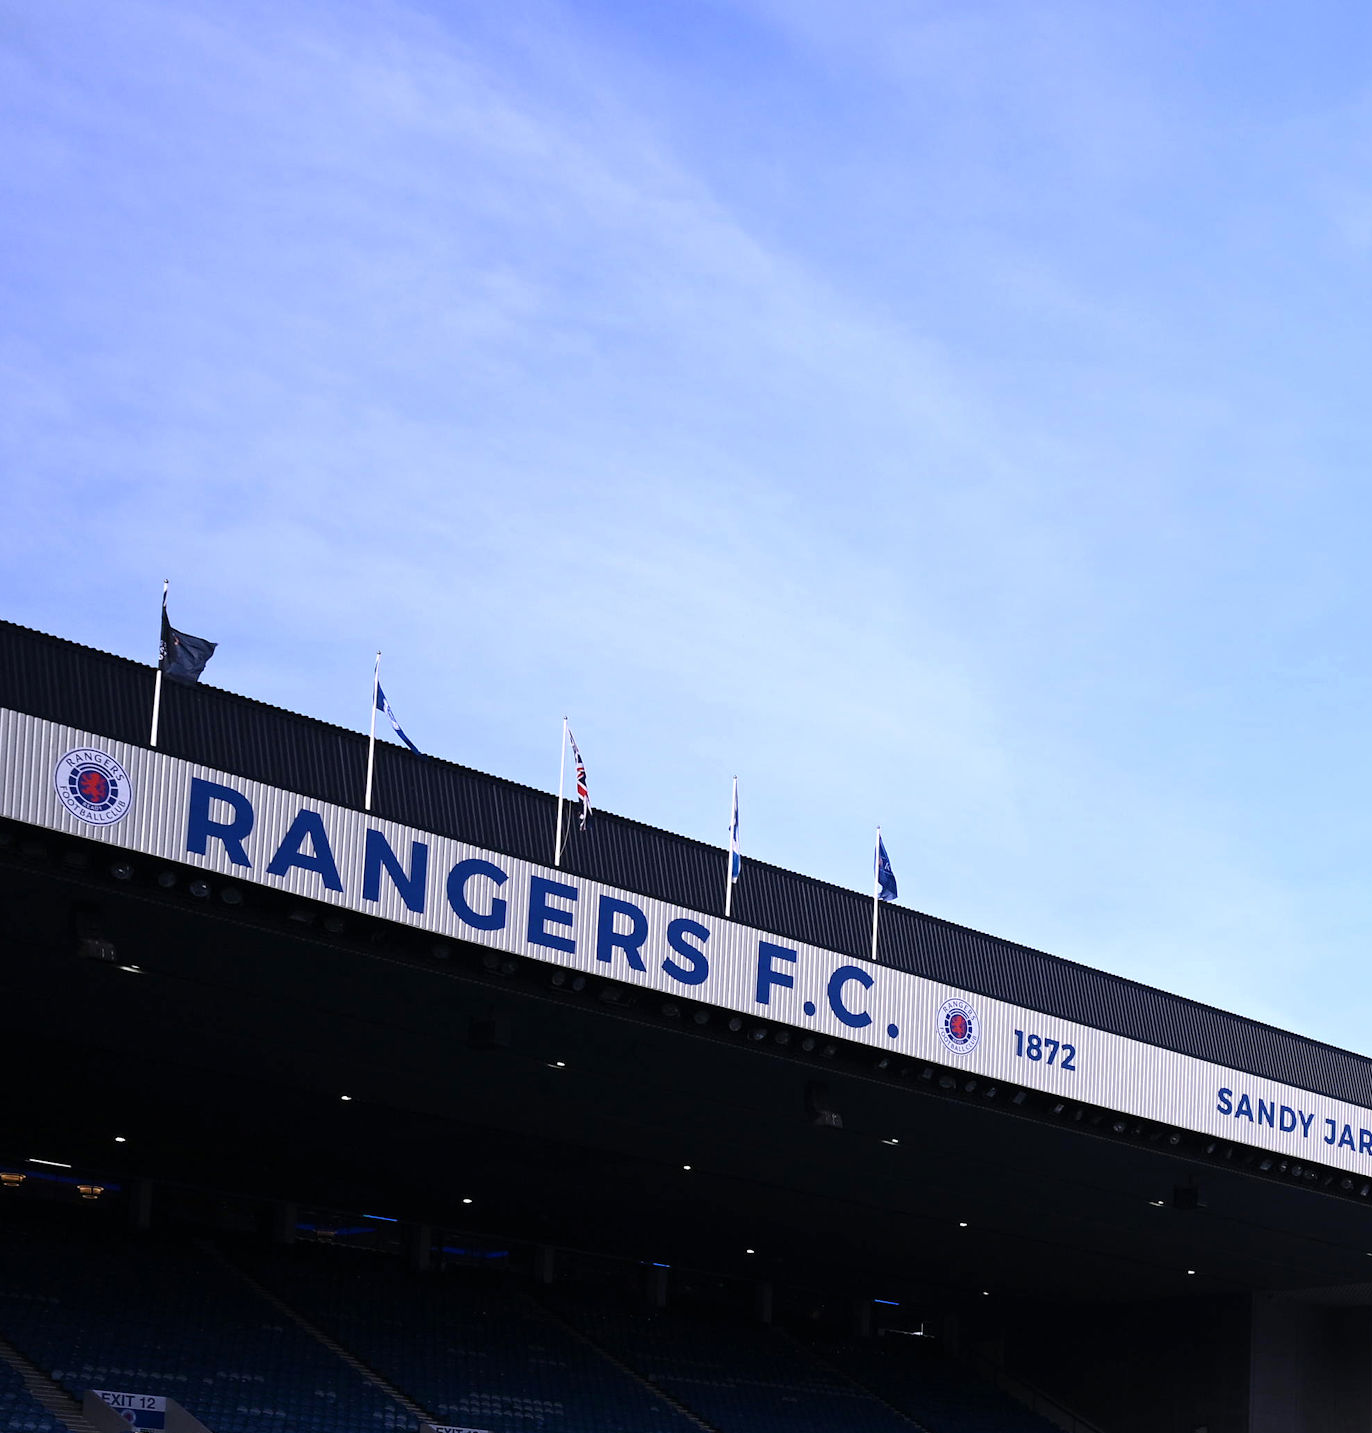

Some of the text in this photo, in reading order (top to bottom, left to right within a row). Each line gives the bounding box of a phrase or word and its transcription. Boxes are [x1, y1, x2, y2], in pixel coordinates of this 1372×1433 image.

[65, 752, 125, 781] RANGERS
[60, 786, 126, 820] FOOTBALL CLUB
[186, 777, 899, 1038] RANGERS F.C.
[943, 1001, 976, 1021] RANGERS
[940, 1027, 977, 1051] FOOTBALL CLUB
[1014, 1029, 1076, 1071] 1872
[1216, 1087, 1314, 1138] SANDY
[139, 1396, 156, 1409] 12
